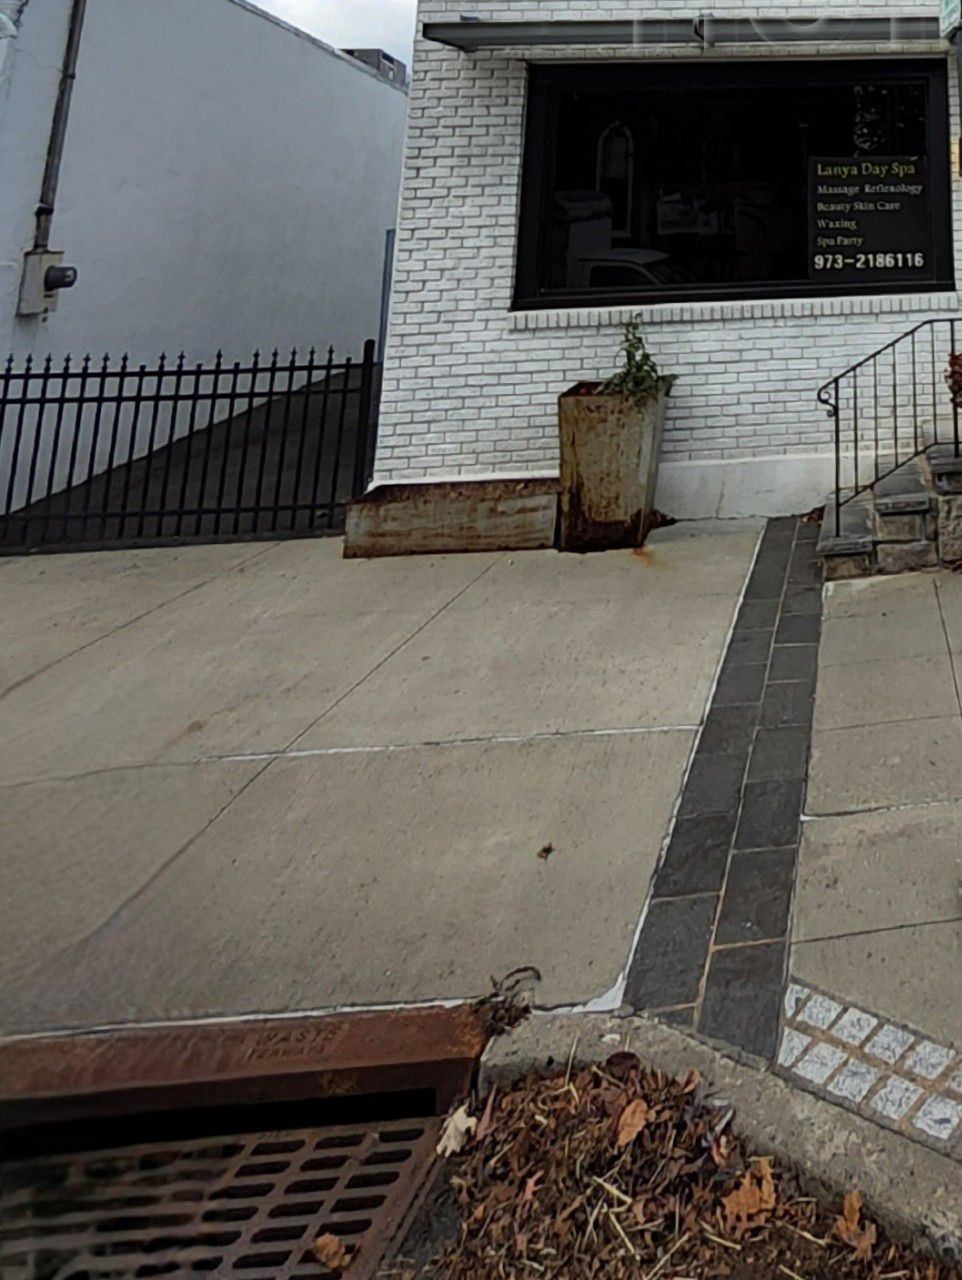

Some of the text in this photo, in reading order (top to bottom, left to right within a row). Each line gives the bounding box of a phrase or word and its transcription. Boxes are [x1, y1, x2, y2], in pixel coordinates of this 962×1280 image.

[817, 161, 916, 178] Lanya Day Spa
[816, 183, 923, 197] Massage Reflexology
[816, 200, 901, 214] Beauty Skin Care
[816, 219, 857, 231] Waxing
[816, 235, 864, 248] Spa Party
[813, 252, 925, 270] 973-2186116
